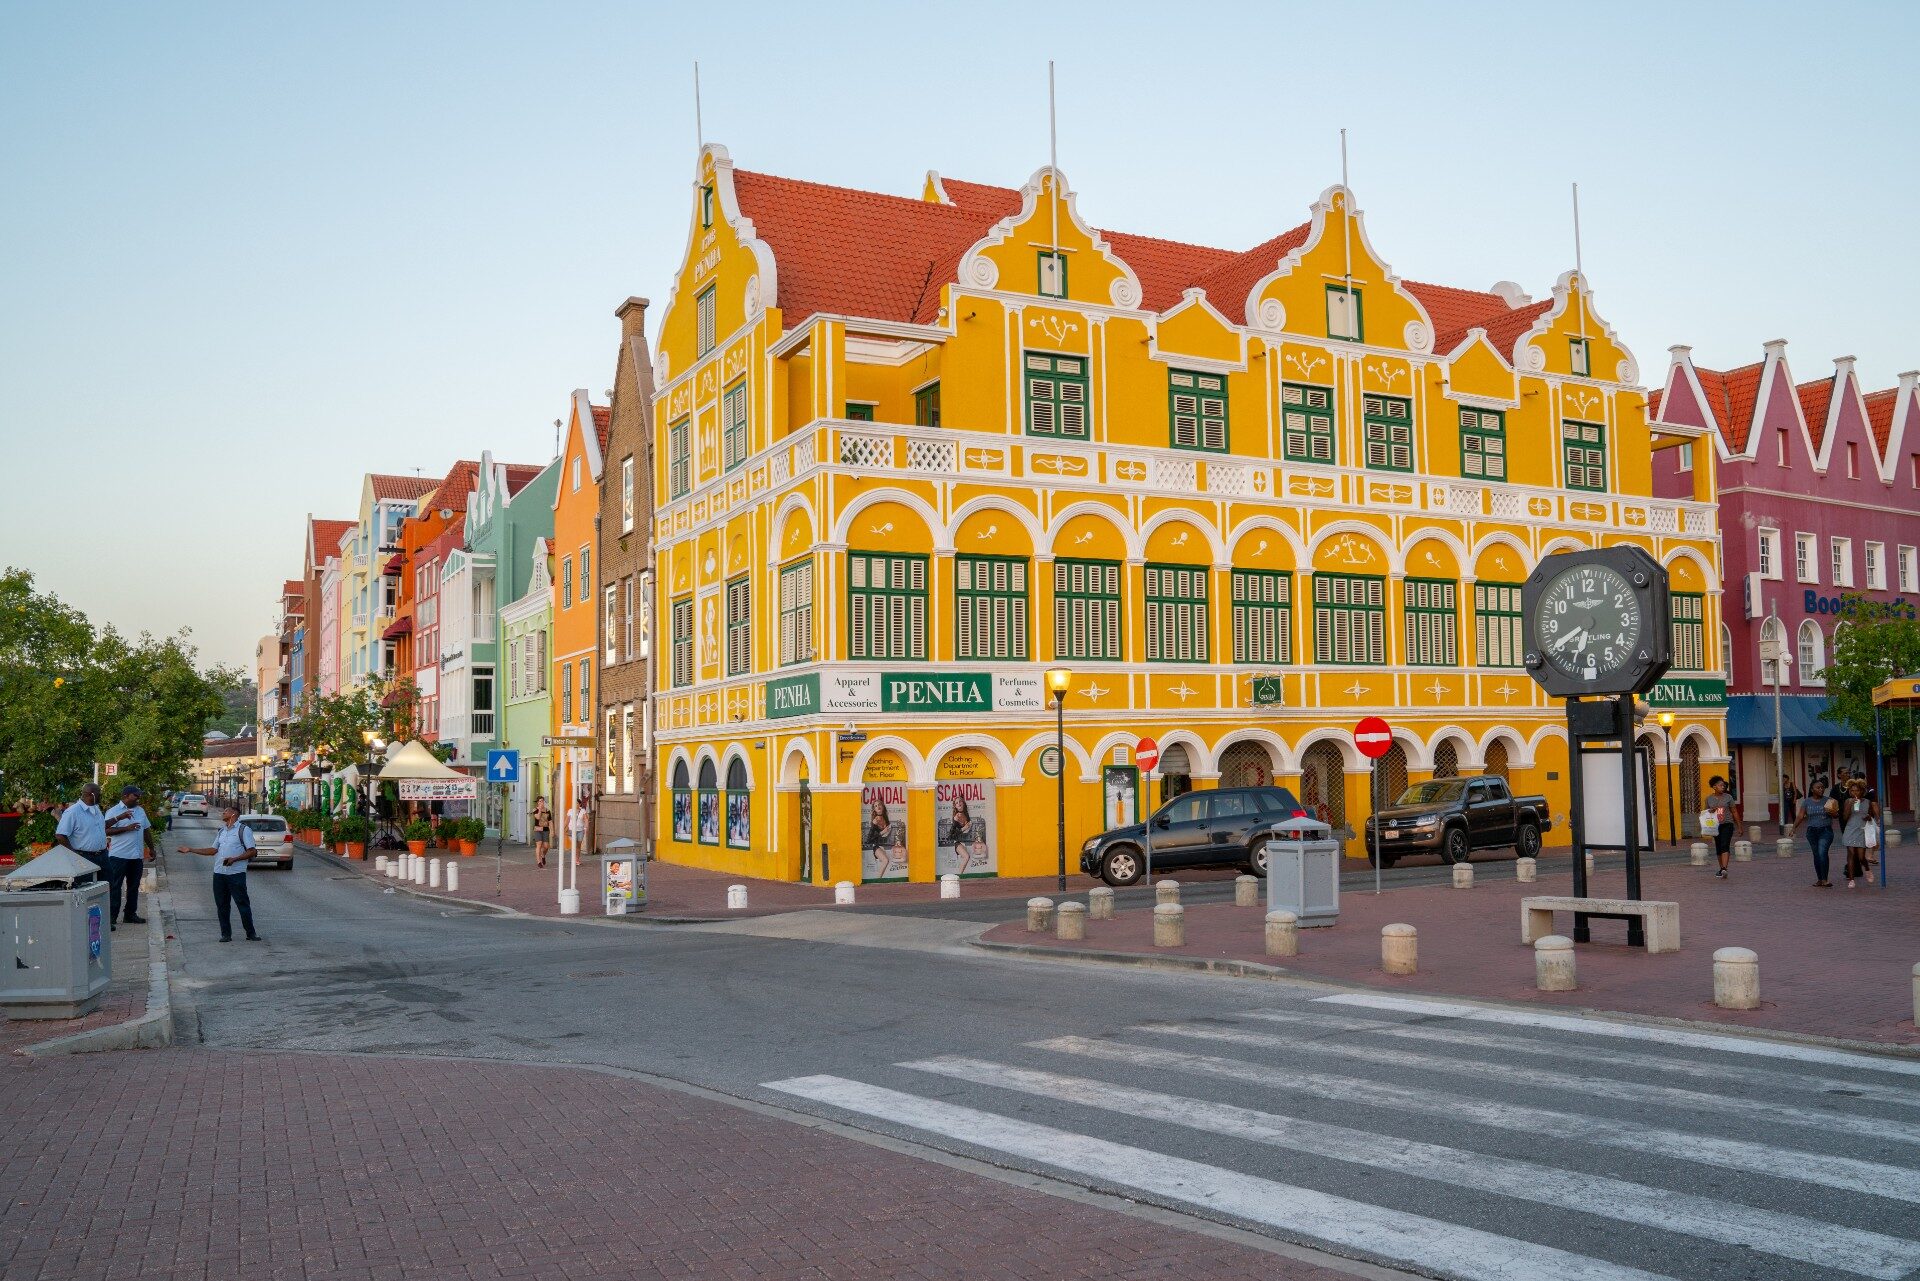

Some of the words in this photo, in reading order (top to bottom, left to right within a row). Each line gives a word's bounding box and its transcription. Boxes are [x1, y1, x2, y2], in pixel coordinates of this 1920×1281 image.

[1566, 586, 1575, 599] 11
[1582, 578, 1595, 593] 12
[1603, 581, 1608, 595] 1
[1554, 600, 1567, 614] 10
[1614, 594, 1624, 609] 2
[1549, 619, 1558, 633] 9
[1620, 613, 1630, 627] 3
[1615, 632, 1625, 647] 4
[1571, 649, 1579, 663] 7
[1586, 653, 1596, 667] 6
[1604, 646, 1613, 661] 5
[834, 677, 870, 689] Apparel
[999, 677, 1038, 687] Perfumes
[774, 683, 811, 710] PENHA
[848, 688, 856, 697] &
[889, 681, 984, 704] PENHA
[1014, 687, 1022, 696] &
[1698, 694, 1704, 702] &
[1704, 693, 1722, 702] SONS
[827, 699, 878, 708] Accessories
[998, 698, 1040, 707] Cosmetics
[868, 758, 893, 766] Clothing
[948, 755, 973, 763] Clothing
[862, 786, 906, 805] CANDAL
[937, 782, 986, 802] SCANDAL
